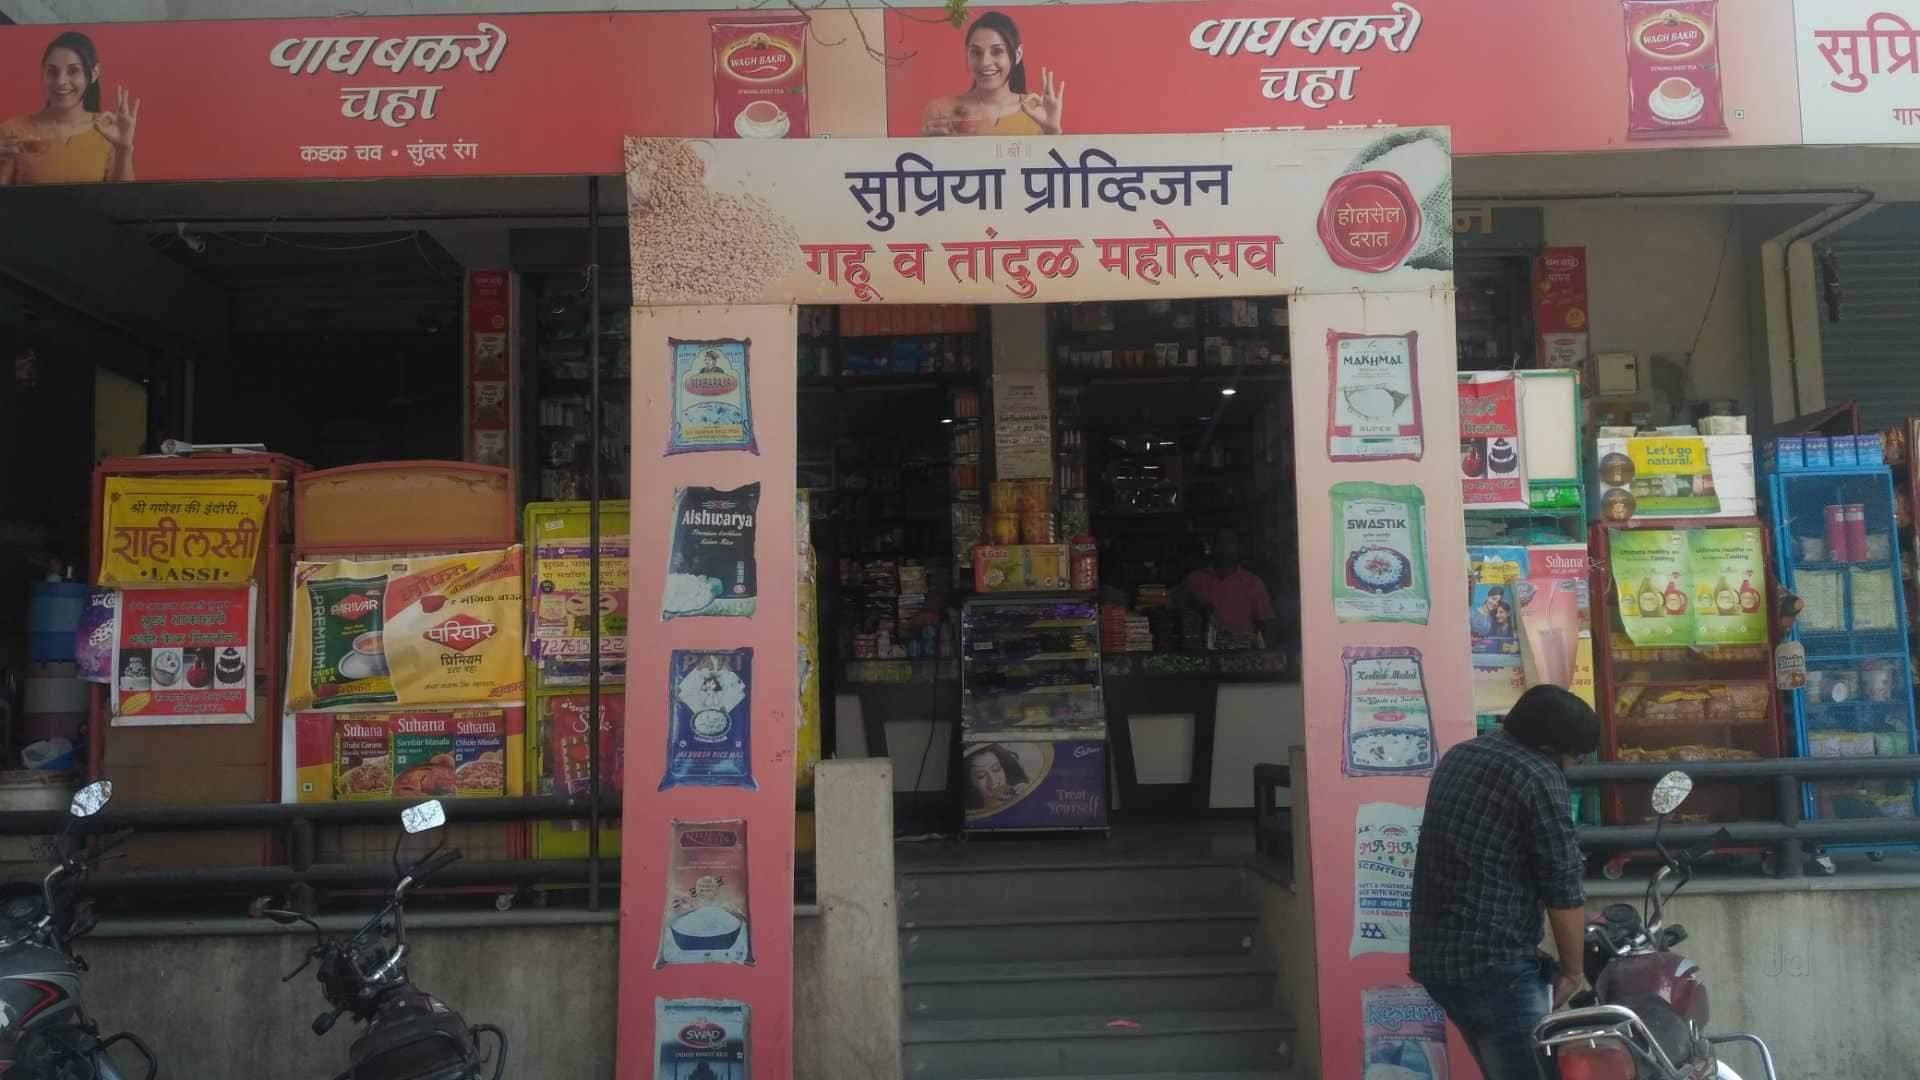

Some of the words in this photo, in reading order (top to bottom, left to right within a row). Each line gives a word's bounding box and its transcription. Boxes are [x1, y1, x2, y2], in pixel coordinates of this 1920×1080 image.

[1644, 32, 1670, 44] WAGH
[1671, 31, 1698, 42] BAKRI
[731, 56, 758, 68] WAGH
[758, 54, 786, 66] BAKRI
[1260, 66, 1361, 109] चहा
[340, 85, 444, 127] चहा
[300, 143, 349, 162] कडक
[356, 143, 383, 162] चव
[407, 142, 447, 165] सुंदर
[453, 141, 479, 160] रंग
[844, 152, 1006, 232] सुप्रिया
[1021, 148, 1233, 213] प्रोव्हिजन
[1336, 201, 1401, 225] होलसेल
[1349, 229, 1389, 249] दरात
[887, 243, 934, 285] व
[1093, 218, 1284, 285] महोत्सव
[1343, 354, 1405, 367] MAKHMAL
[1646, 445, 1672, 456] Let's
[1676, 447, 1692, 459] go
[130, 501, 147, 513] श्री
[150, 501, 180, 513] गणेश
[184, 500, 201, 513] की
[681, 509, 753, 530] Aishwarya
[1346, 519, 1407, 529] SWASTIK
[112, 516, 181, 565] शाही
[184, 517, 259, 560] लस्सी
[1546, 555, 1584, 569] Suhana
[151, 567, 222, 581] LASSI
[331, 599, 379, 616] PARIVAR
[313, 594, 326, 670] PREMIUM
[427, 620, 497, 643] परिवार
[440, 652, 483, 667] प्रिमियम
[343, 723, 383, 738] Suhana
[398, 718, 446, 733] Suhana
[456, 720, 496, 735] Suhana
[1056, 788, 1088, 801] Treat
[1359, 839, 1418, 856] MAHA
[1358, 862, 1405, 878] SCENTED
[685, 1029, 721, 1043] SWAD
